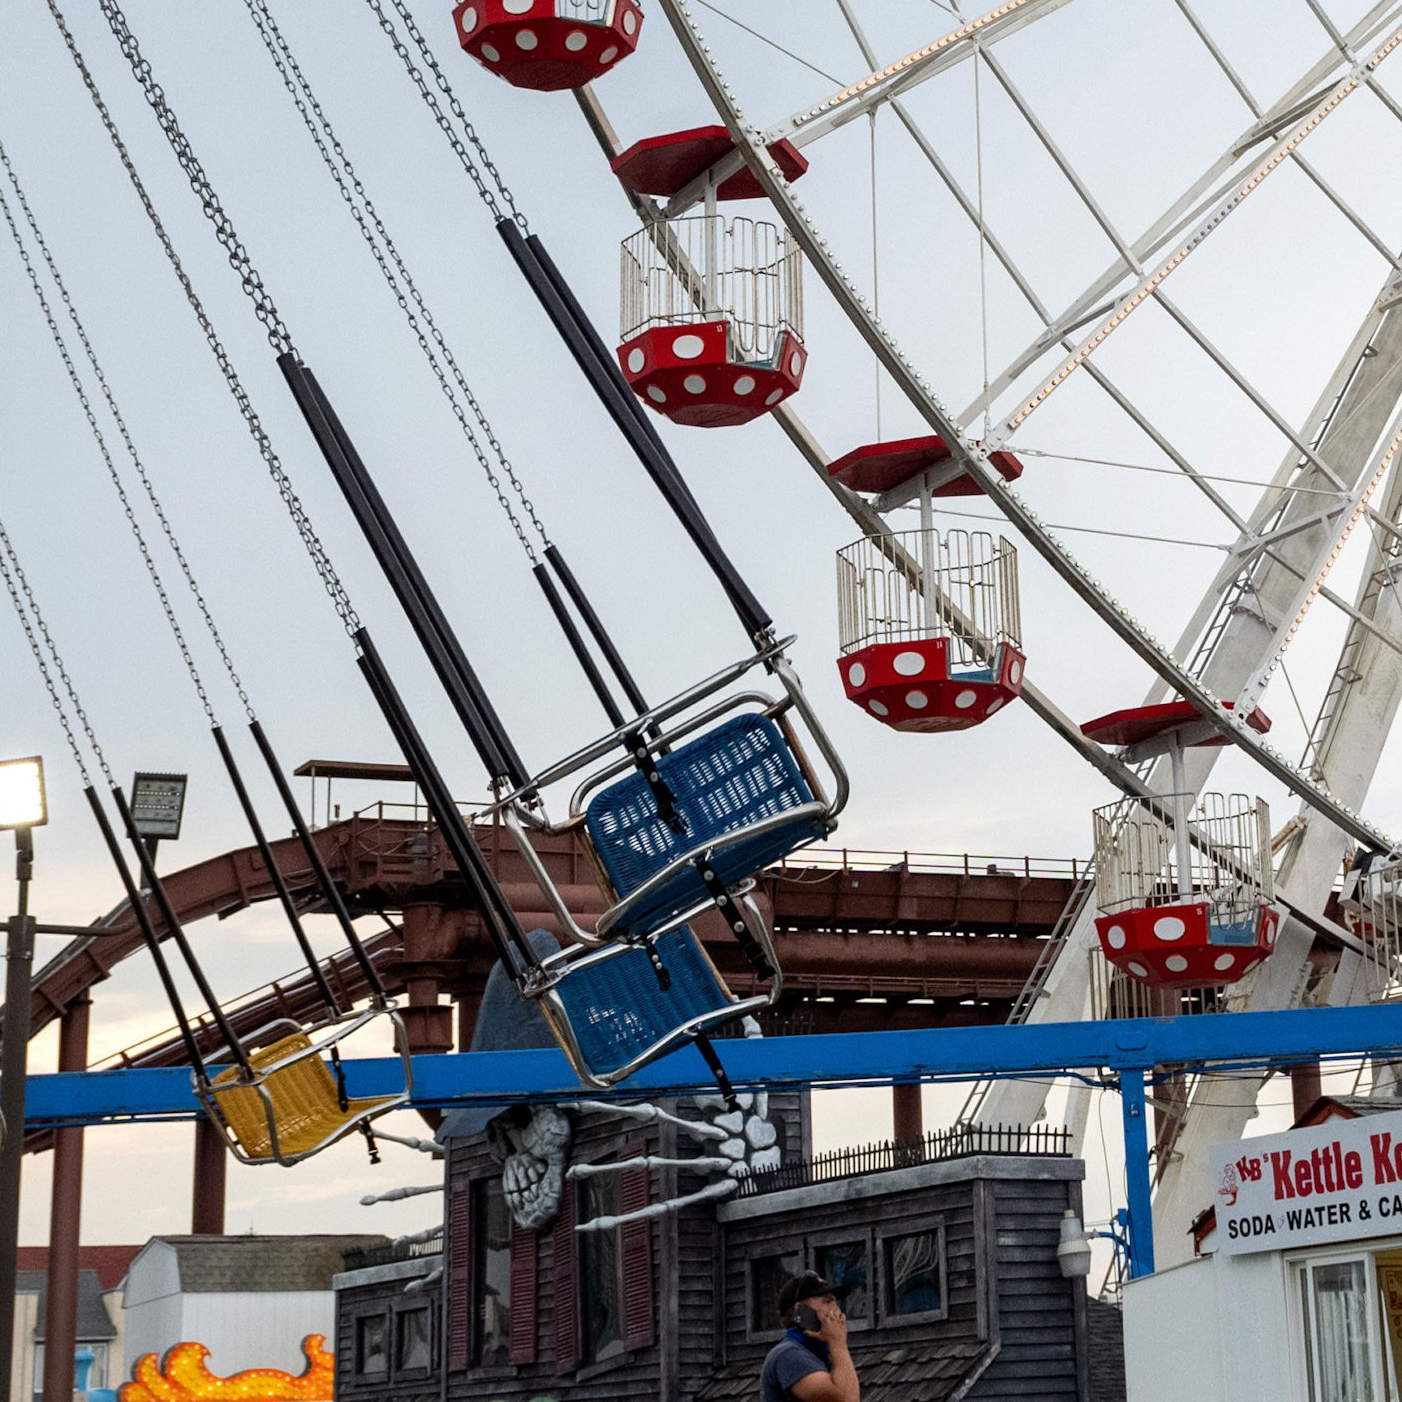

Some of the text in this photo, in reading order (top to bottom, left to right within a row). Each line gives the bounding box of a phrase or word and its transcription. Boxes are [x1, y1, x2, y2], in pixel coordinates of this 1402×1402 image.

[1270, 1141, 1363, 1200] Kettle
[1228, 1214, 1276, 1239] SODA
[1286, 1202, 1352, 1231] WATER
[1359, 1200, 1371, 1220] &
